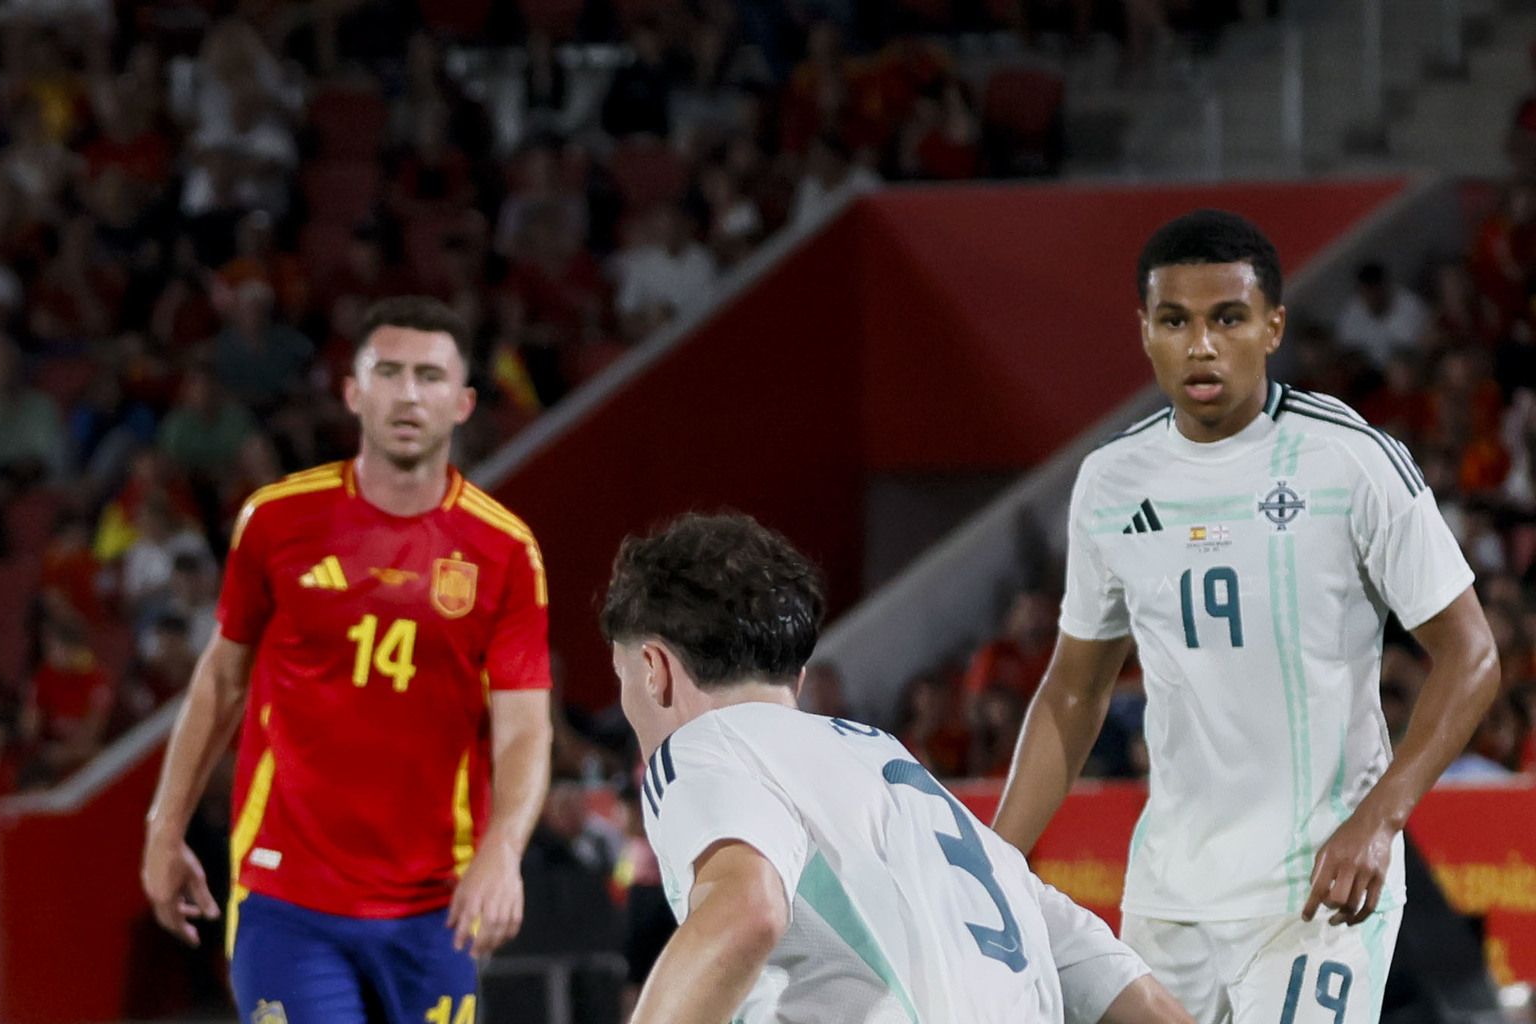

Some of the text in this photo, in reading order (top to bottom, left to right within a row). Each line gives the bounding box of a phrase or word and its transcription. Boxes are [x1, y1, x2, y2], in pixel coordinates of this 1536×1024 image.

[1180, 566, 1245, 649] 19
[348, 613, 417, 692] 14
[882, 758, 1029, 974] 3
